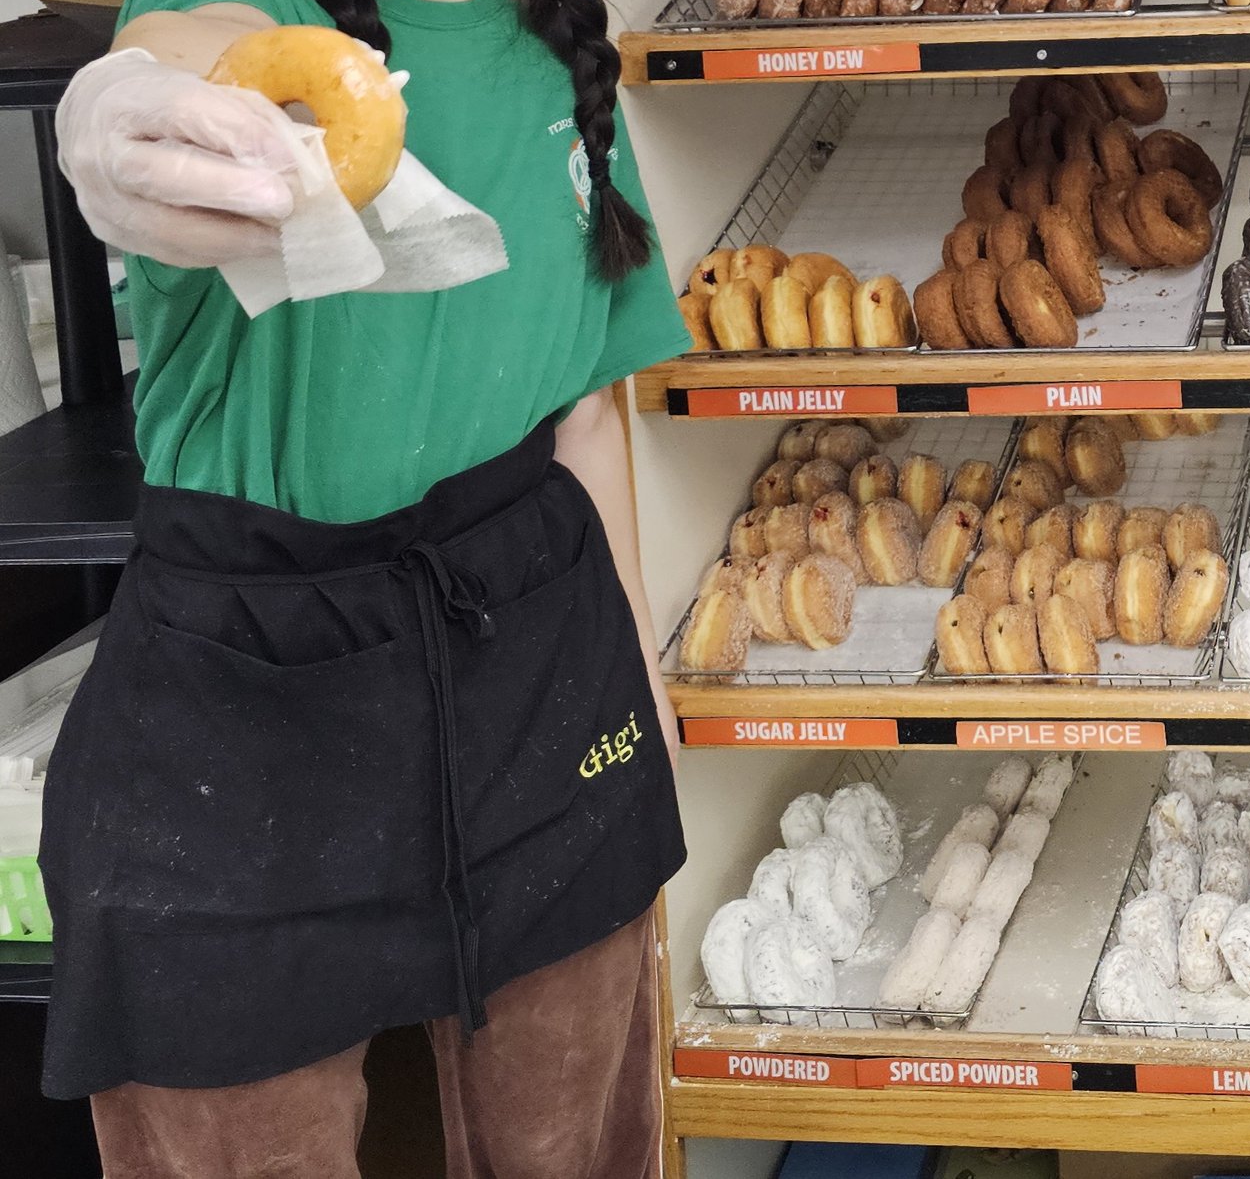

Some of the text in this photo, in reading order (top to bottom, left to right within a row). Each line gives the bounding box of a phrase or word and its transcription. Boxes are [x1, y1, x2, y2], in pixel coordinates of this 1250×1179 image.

[758, 49, 864, 73] HONEY DEW
[739, 390, 845, 412] PLAIN JELLY
[1046, 385, 1102, 407] PLAIN
[734, 721, 847, 741] SUGAR JELLY
[972, 724, 1142, 745] APPLE SPICE
[579, 711, 643, 778] Gigi
[729, 1056, 830, 1081] POWDERED
[889, 1061, 1039, 1086] SPICED POWDER
